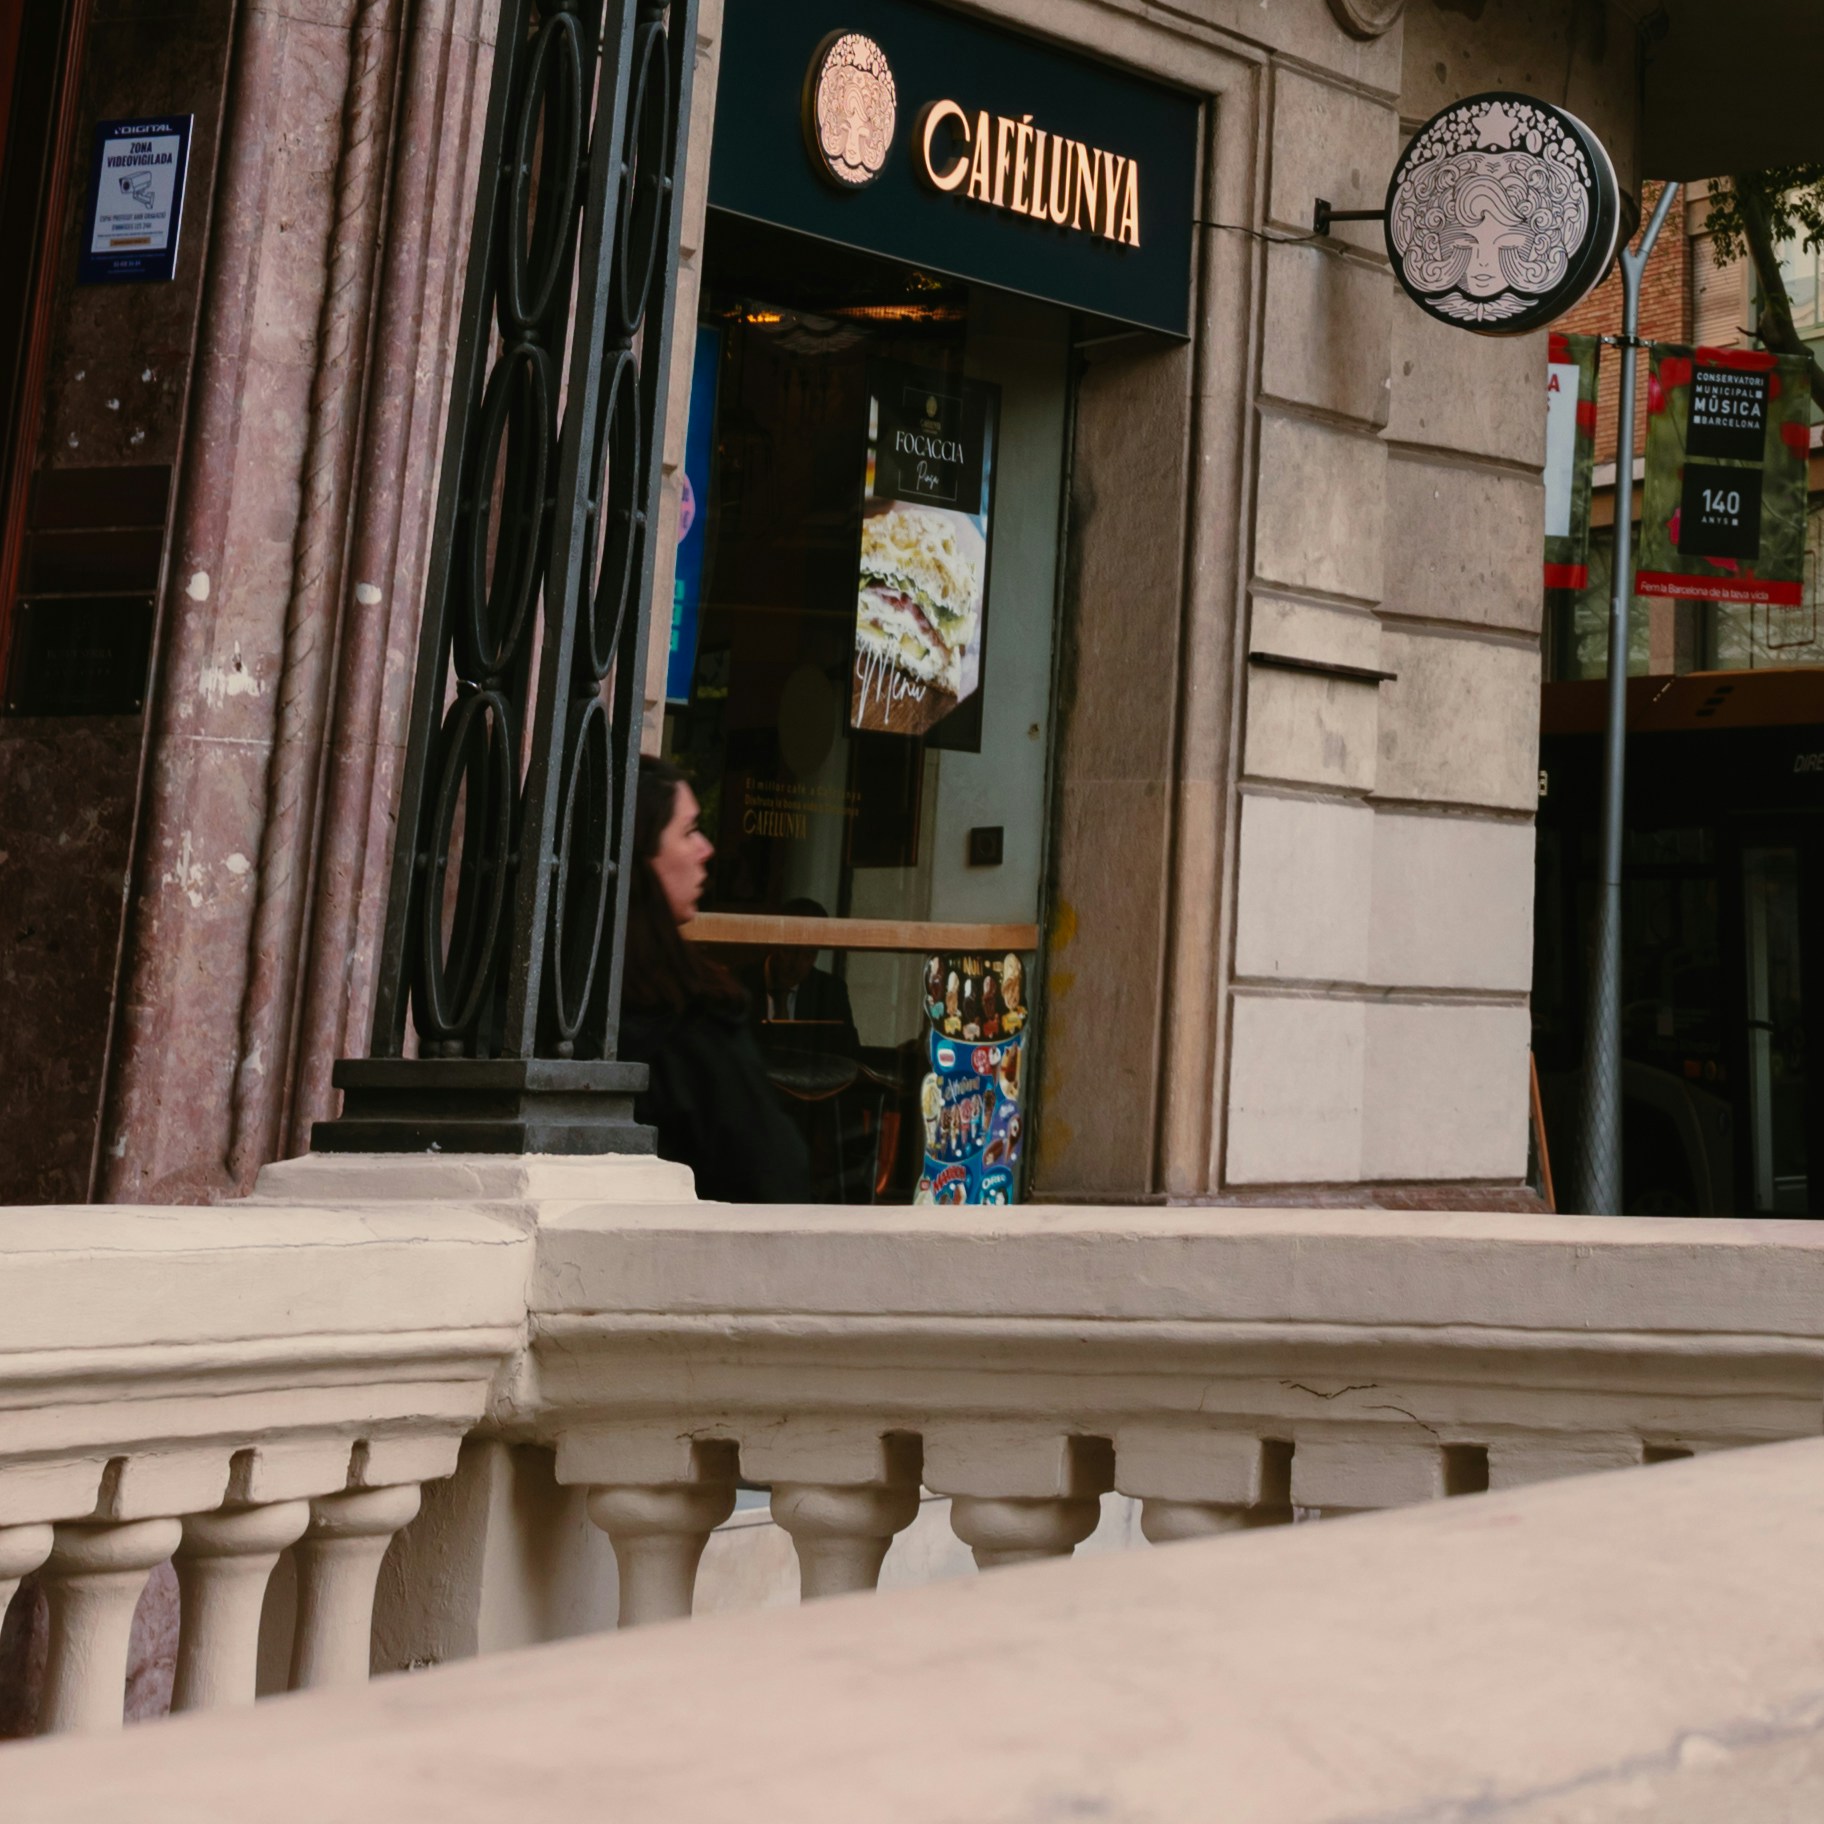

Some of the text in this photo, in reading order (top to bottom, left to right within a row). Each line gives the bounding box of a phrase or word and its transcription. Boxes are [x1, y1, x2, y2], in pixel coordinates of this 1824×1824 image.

[130, 142, 152, 154] ZONA
[107, 153, 172, 167] VIDEOVIGILADA
[923, 99, 1140, 247] CAFÉLUNYA
[1696, 372, 1764, 386] CONSERVATORI
[1695, 384, 1754, 397] MUNICIPAL
[1701, 415, 1760, 429] BARCELONA
[895, 430, 964, 464] FOCACCIA
[1702, 488, 1740, 514] 140
[1701, 516, 1729, 525] ANYS
[1640, 580, 1769, 601] Fem la Barcelona de la teva vida
